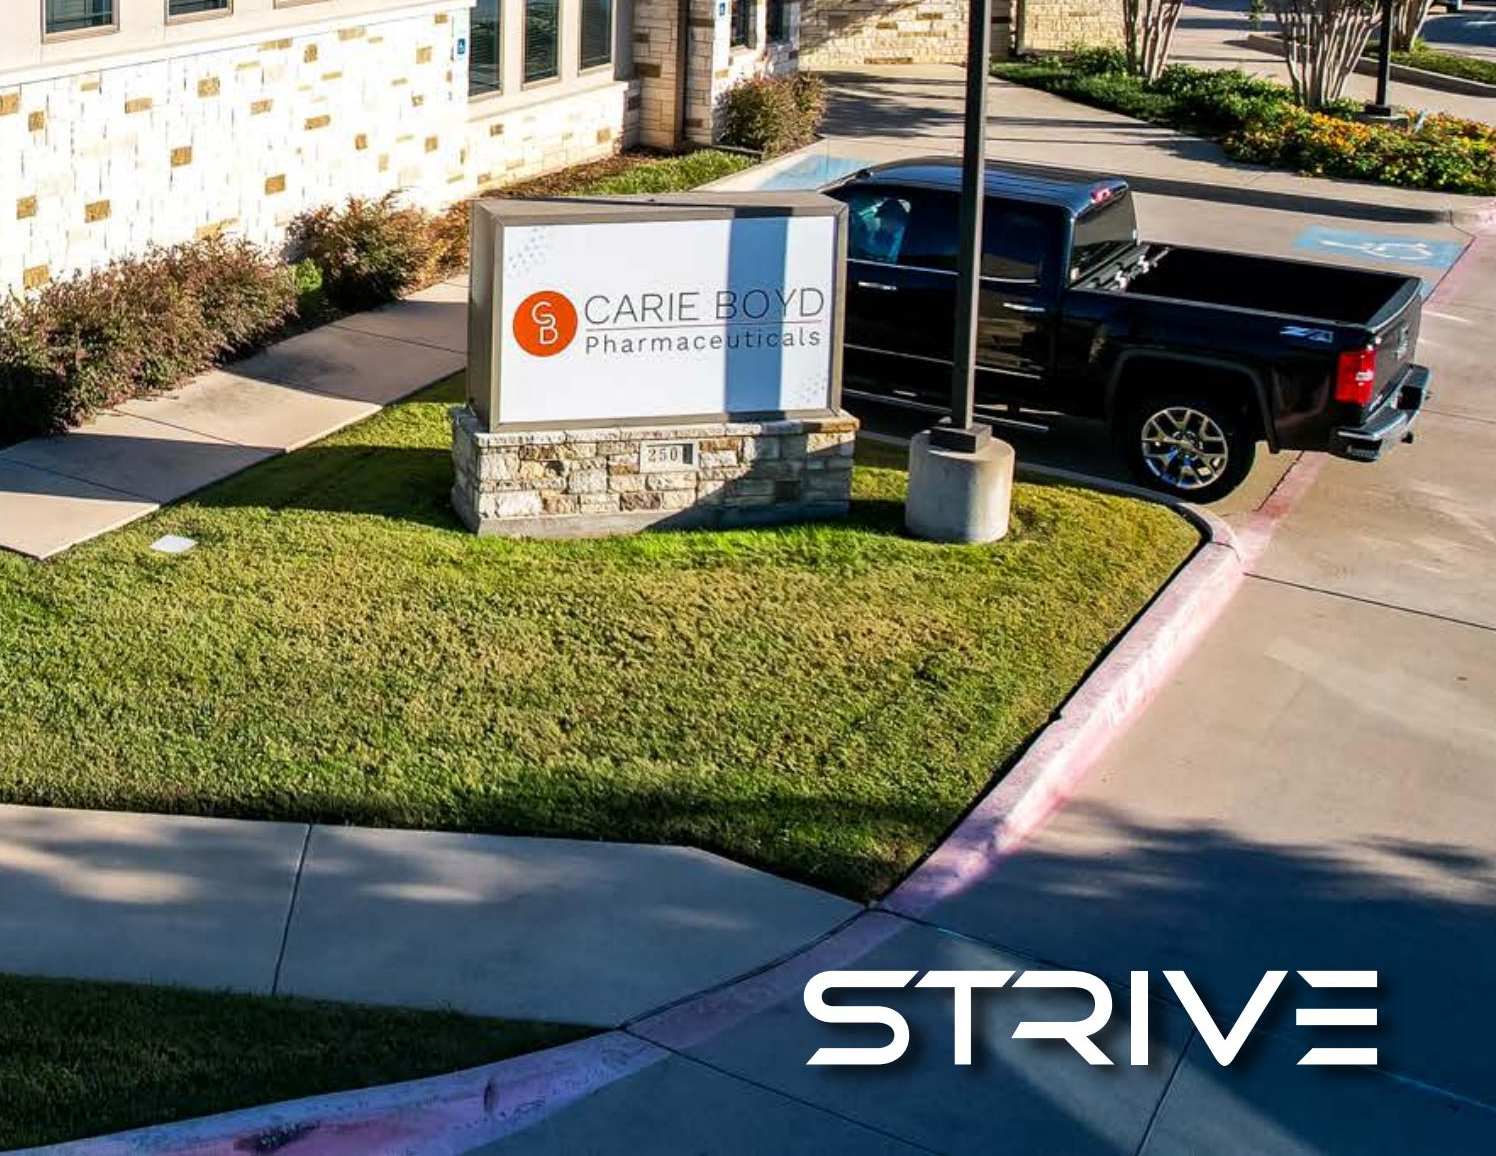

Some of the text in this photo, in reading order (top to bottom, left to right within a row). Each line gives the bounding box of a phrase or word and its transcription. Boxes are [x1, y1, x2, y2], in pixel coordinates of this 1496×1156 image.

[584, 287, 824, 324] CARIE BOYD
[585, 328, 821, 354] Pharmaceuticals
